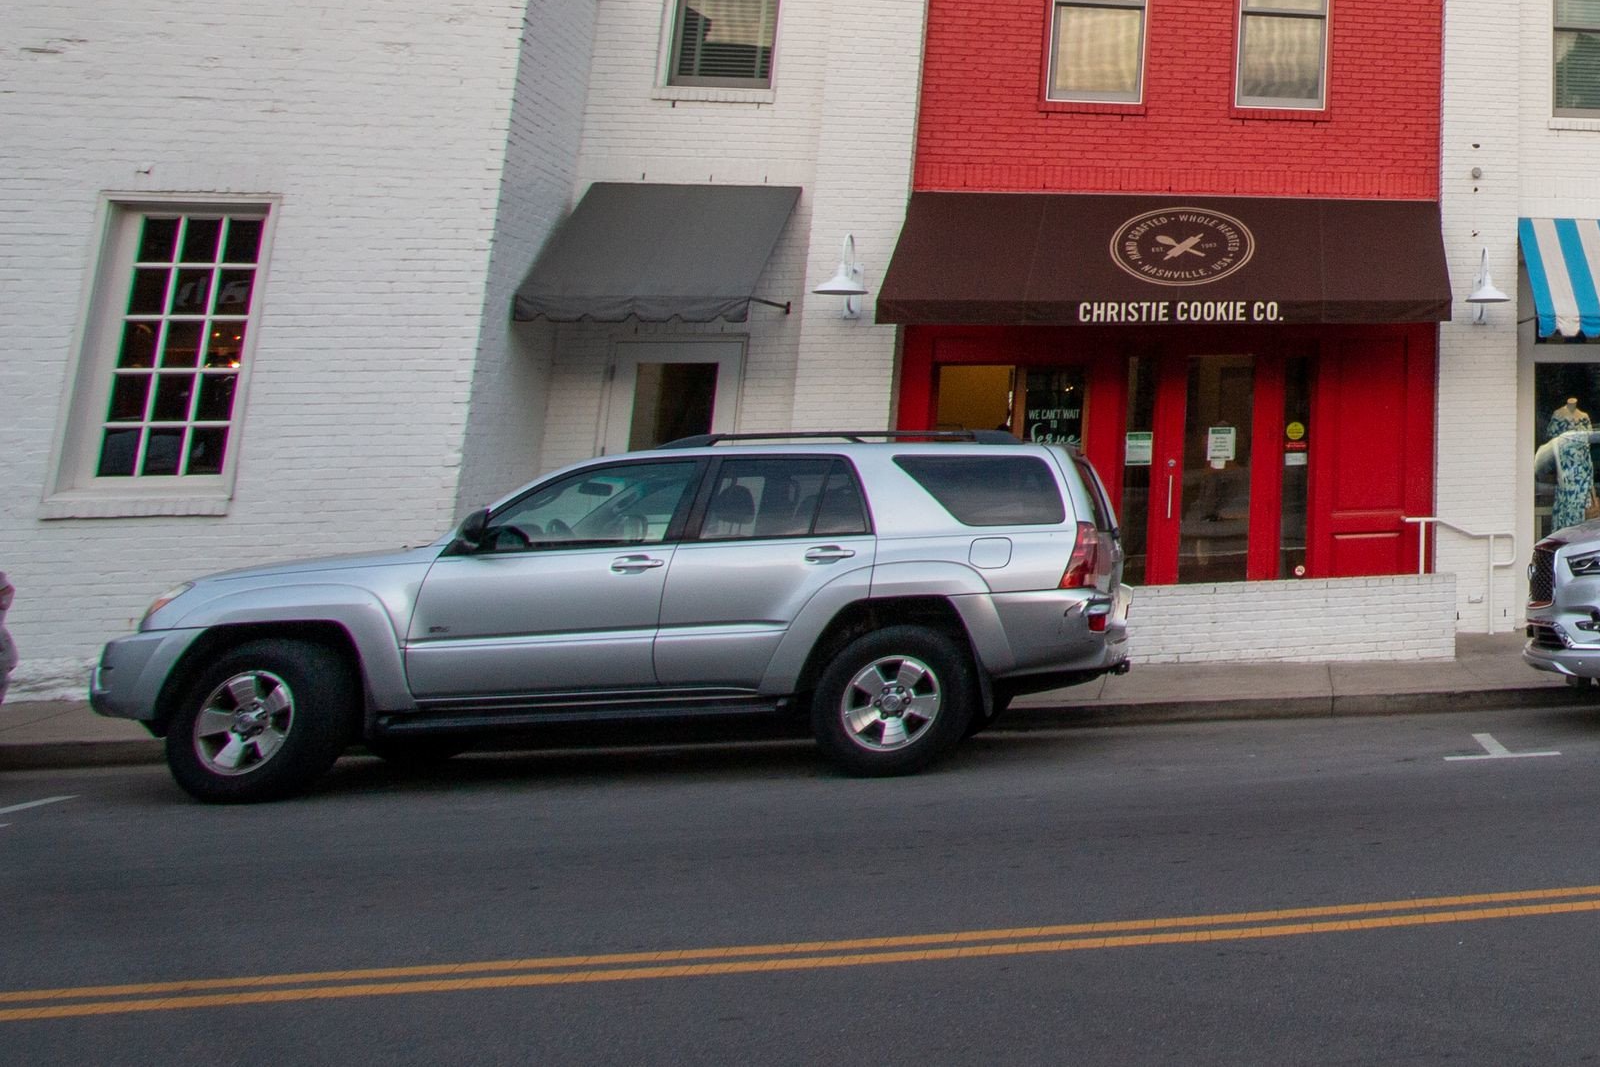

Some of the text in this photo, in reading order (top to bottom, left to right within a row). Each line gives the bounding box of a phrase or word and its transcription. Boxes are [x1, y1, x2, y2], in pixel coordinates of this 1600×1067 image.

[1125, 214, 1240, 260] HAND CRAFTED WHOLE HEARTED
[1211, 257, 1233, 271] USA
[1079, 301, 1284, 322] CHRISTIE COOKIE CO.
[1029, 409, 1040, 420] WE
[1062, 409, 1080, 420] WAIT
[1050, 420, 1058, 429] TO
